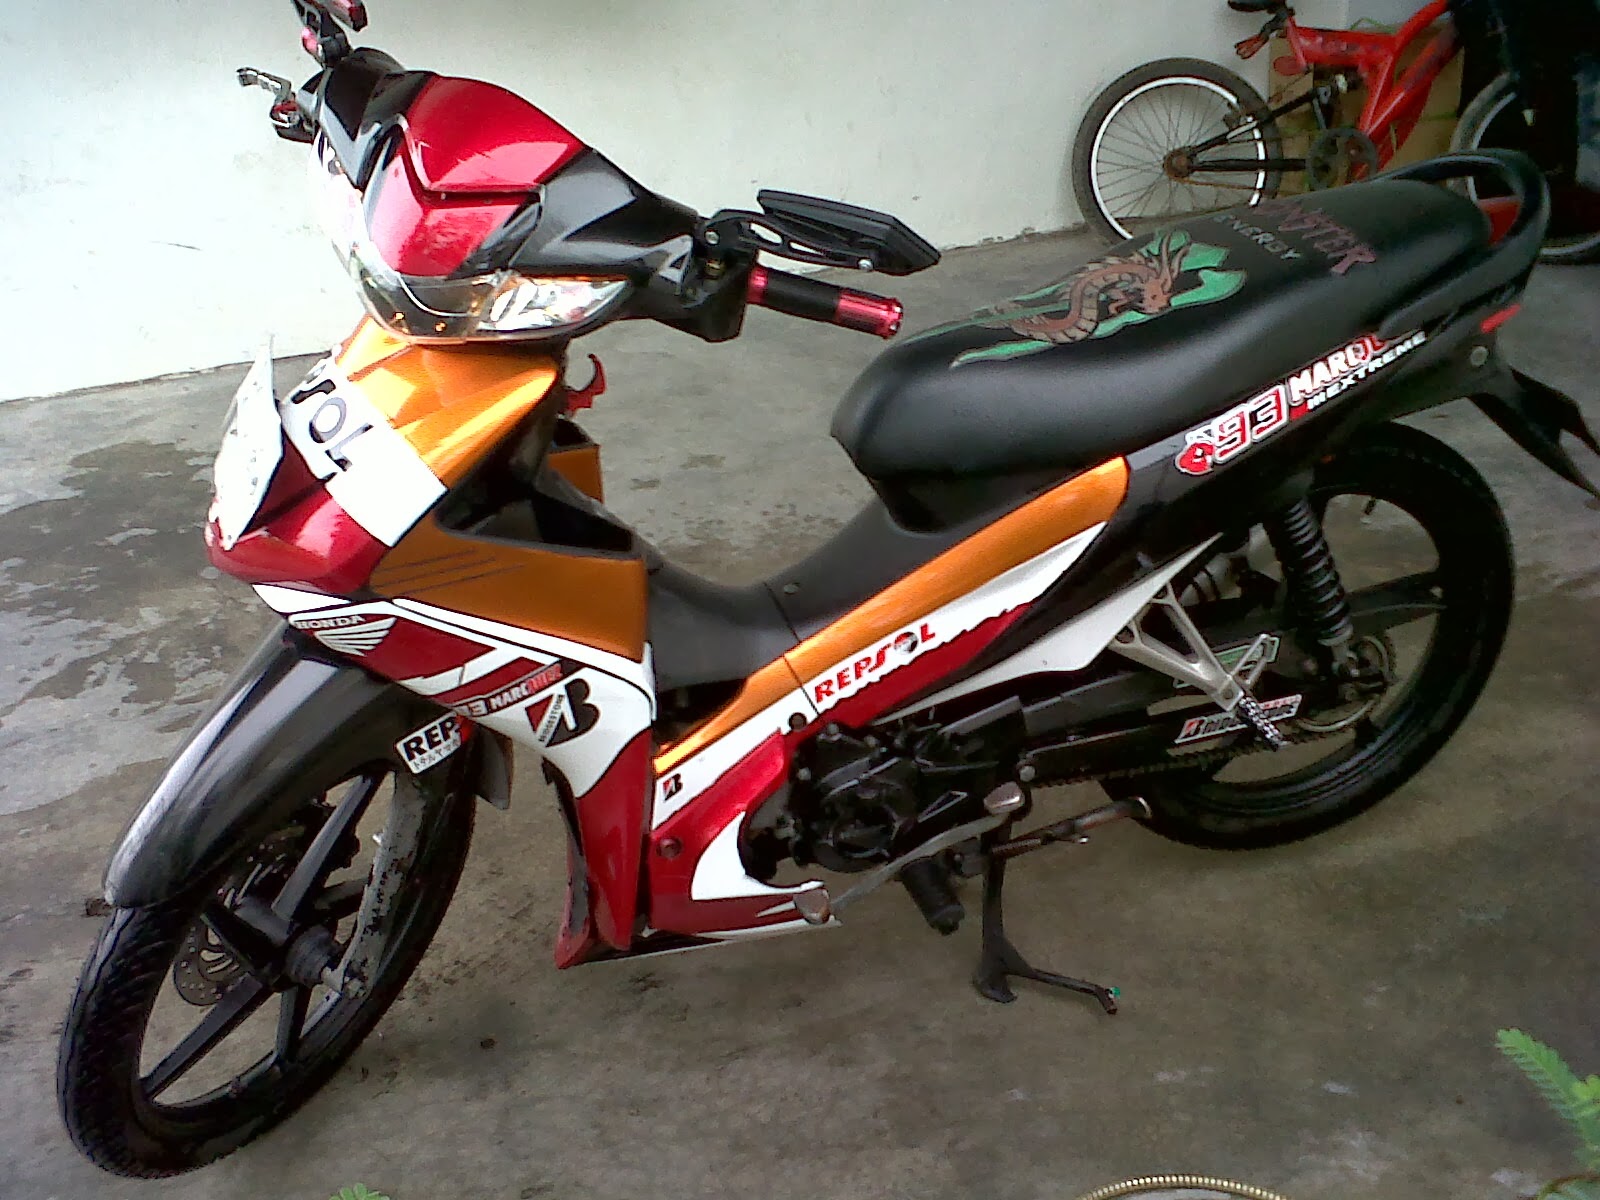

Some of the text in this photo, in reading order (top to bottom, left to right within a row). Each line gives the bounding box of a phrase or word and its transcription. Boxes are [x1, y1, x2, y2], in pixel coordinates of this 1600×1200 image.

[291, 363, 373, 472] SOL
[295, 614, 366, 630] HONDA
[814, 623, 936, 704] REPSOL
[403, 715, 462, 762] REP
